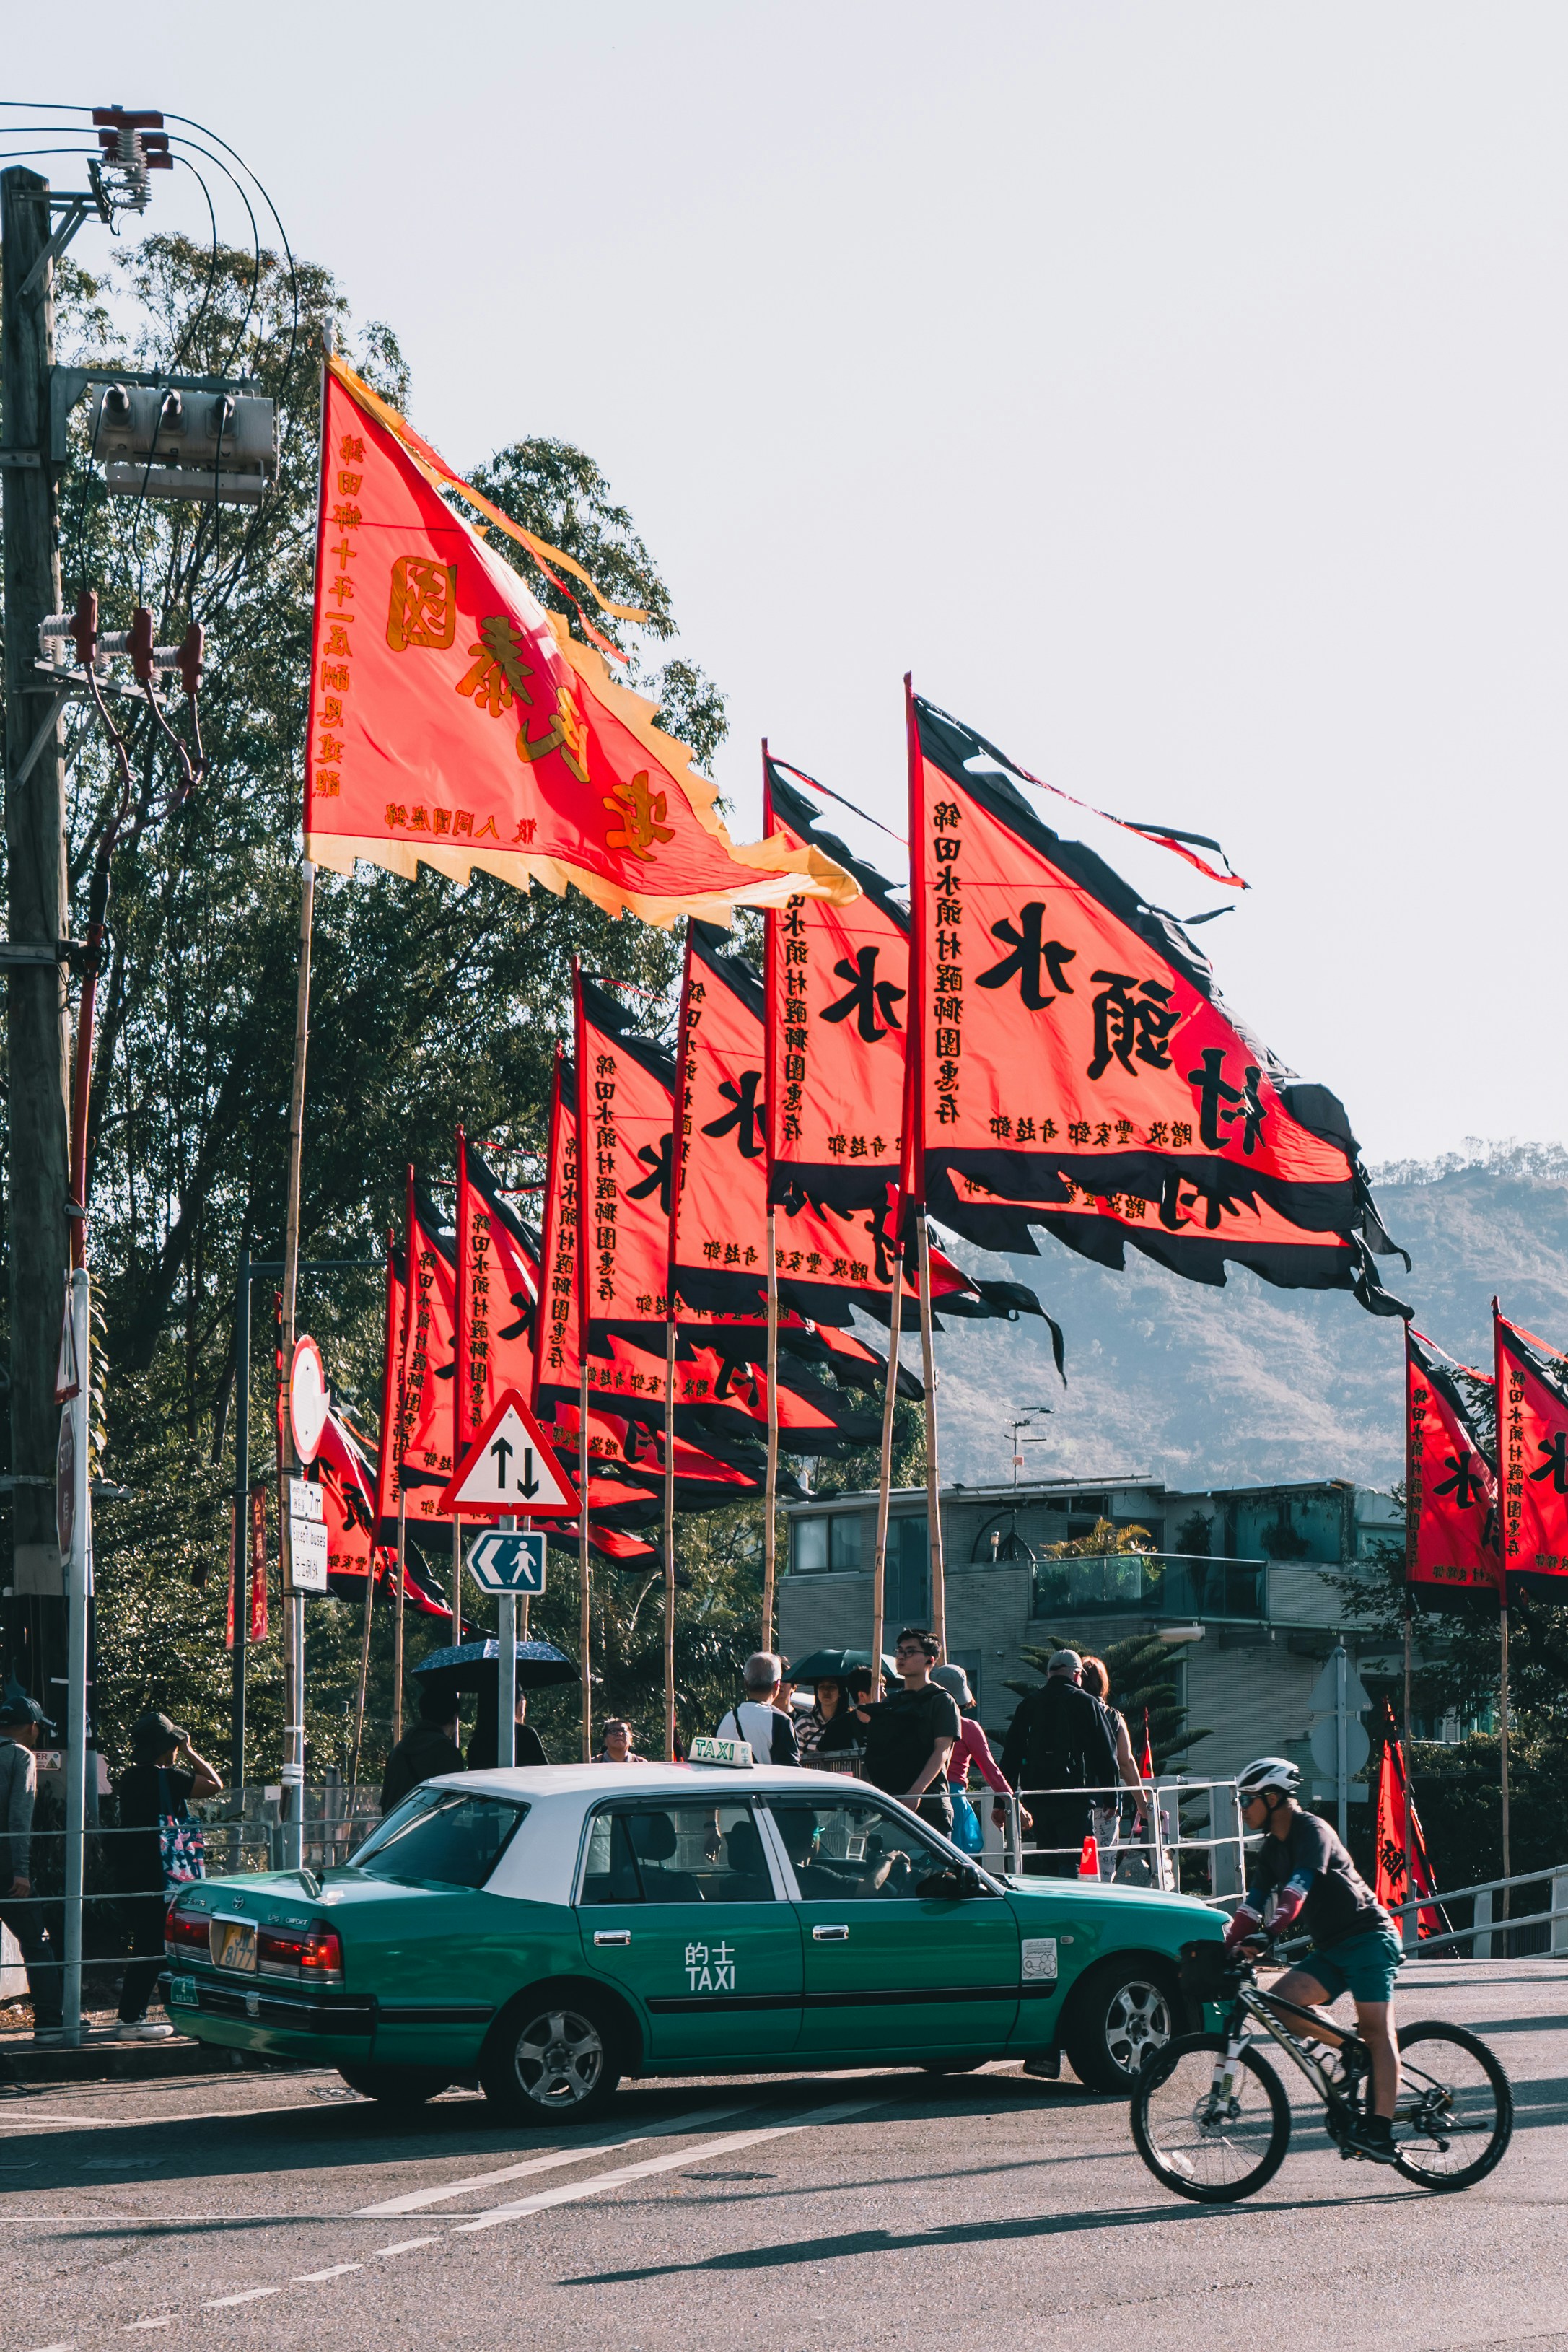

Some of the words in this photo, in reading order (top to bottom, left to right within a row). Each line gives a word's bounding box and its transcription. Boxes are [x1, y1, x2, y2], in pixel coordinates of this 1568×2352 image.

[695, 1739, 735, 1761] TAXI
[740, 1747, 749, 1764] 的士
[225, 1945, 255, 1969] 8177
[685, 1941, 735, 1966] 的士
[685, 1966, 736, 1991] TAXI
[175, 1994, 194, 2003] SEATS
